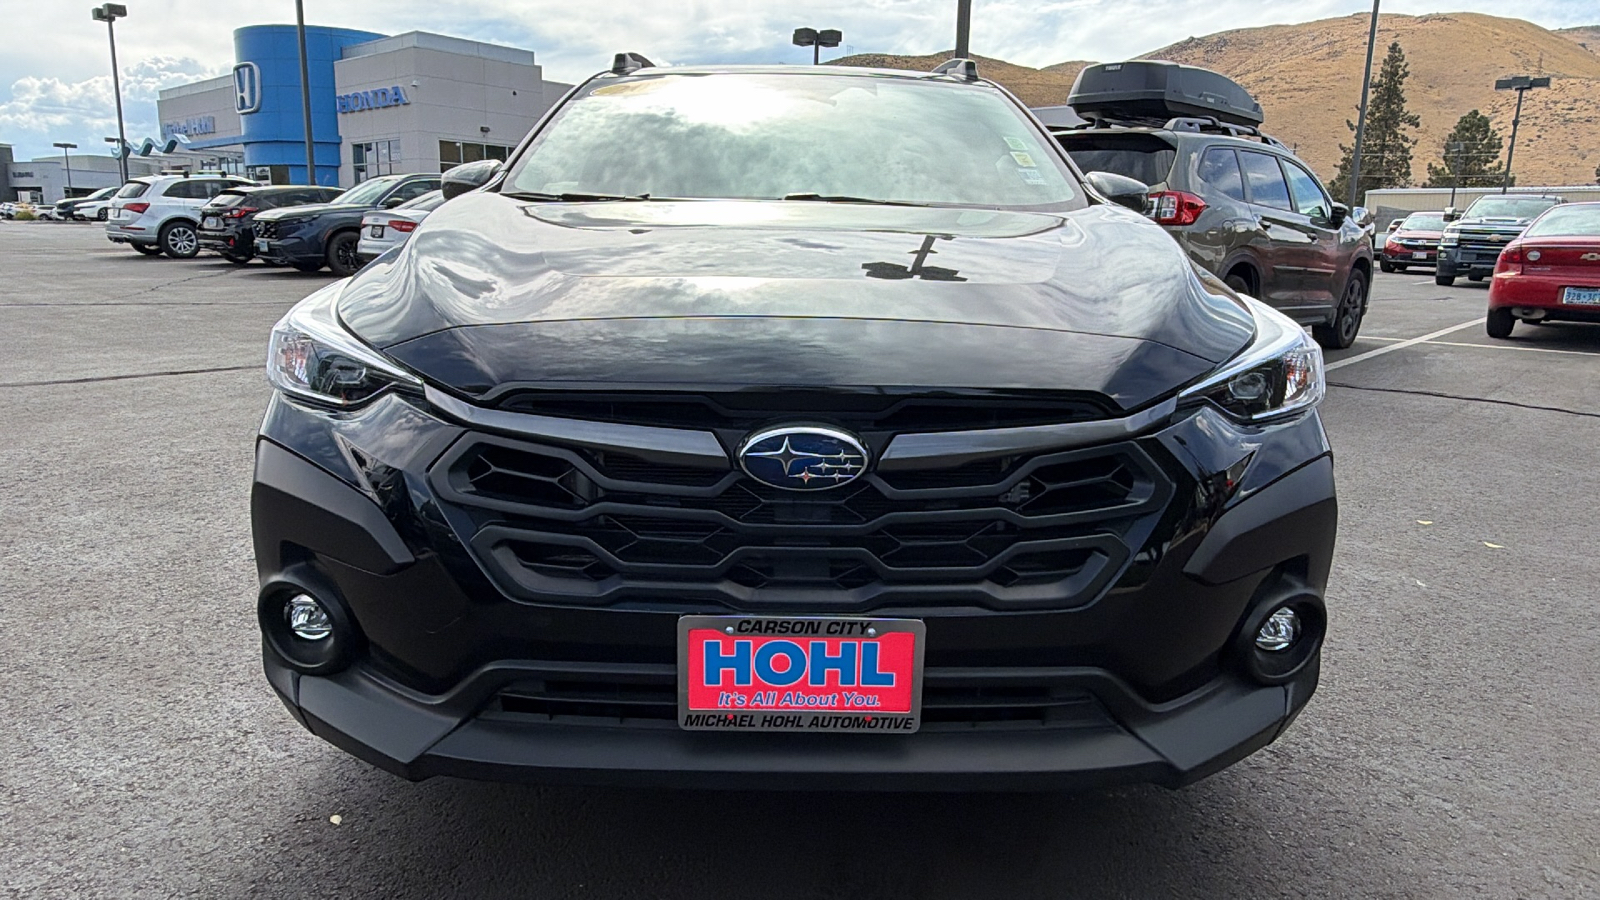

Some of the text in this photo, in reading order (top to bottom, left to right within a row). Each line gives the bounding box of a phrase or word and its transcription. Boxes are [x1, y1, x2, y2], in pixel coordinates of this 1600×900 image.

[336, 86, 410, 113] HONDA
[737, 620, 871, 635] CARSON CITY
[704, 640, 895, 687] HOHL
[718, 692, 881, 707] It's All About You.
[684, 714, 915, 730] MICHAEL HOHL AUTOMOTIVE
